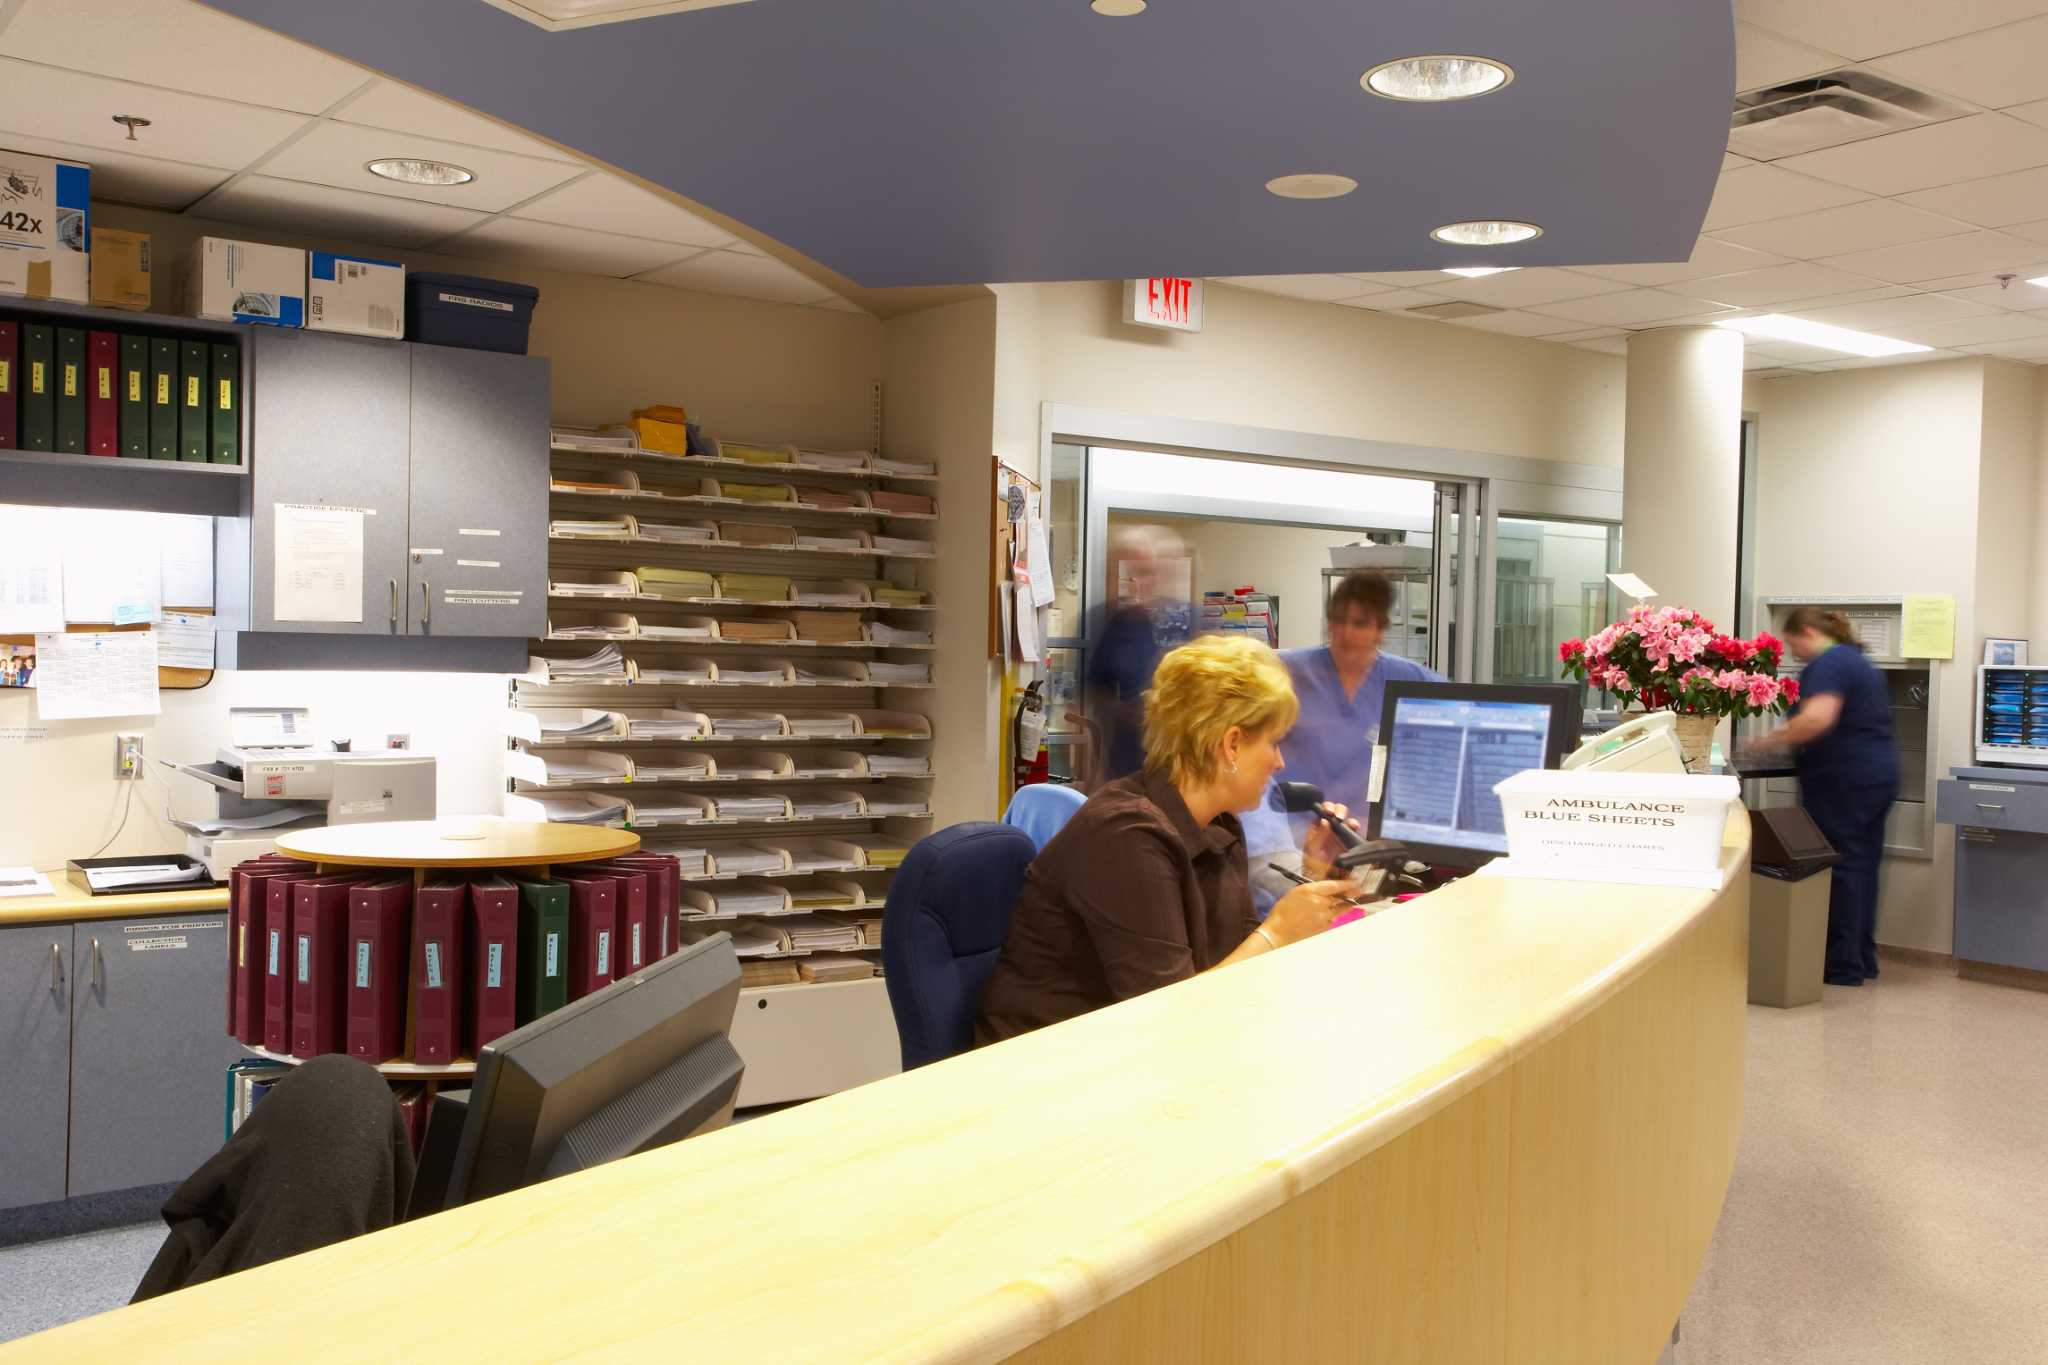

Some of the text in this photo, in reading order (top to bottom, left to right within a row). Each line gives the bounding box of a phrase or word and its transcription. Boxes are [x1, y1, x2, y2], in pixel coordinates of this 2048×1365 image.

[1148, 277, 1192, 325] EXIT
[1547, 799, 1686, 814] AMBULANCE
[1524, 811, 1676, 827] BLUE SHEETS
